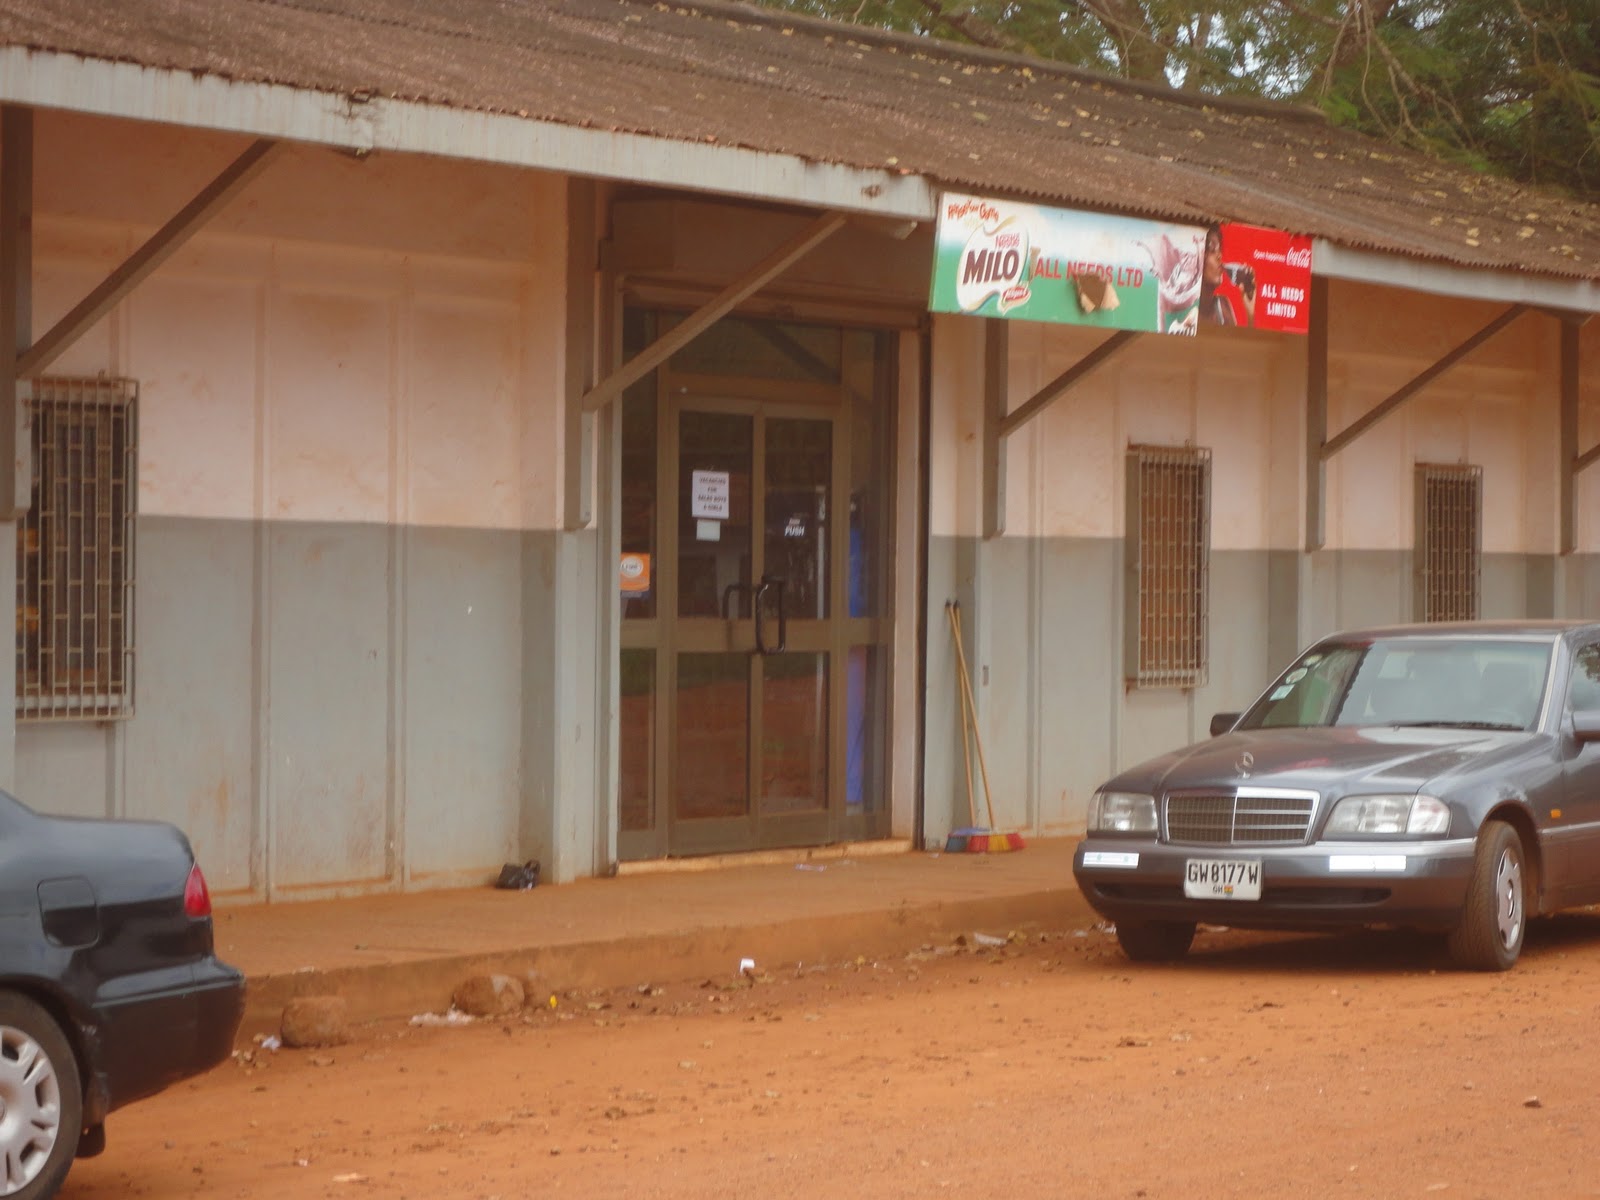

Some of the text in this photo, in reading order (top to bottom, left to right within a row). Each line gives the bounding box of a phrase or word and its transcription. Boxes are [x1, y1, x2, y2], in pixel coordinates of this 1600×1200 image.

[962, 248, 1020, 285] MILO
[1034, 257, 1062, 280] ALL
[1117, 266, 1144, 288] LTD
[1262, 284, 1305, 302] ALL NEEDS
[1266, 302, 1297, 318] LIMITED
[784, 526, 805, 537] PUSH
